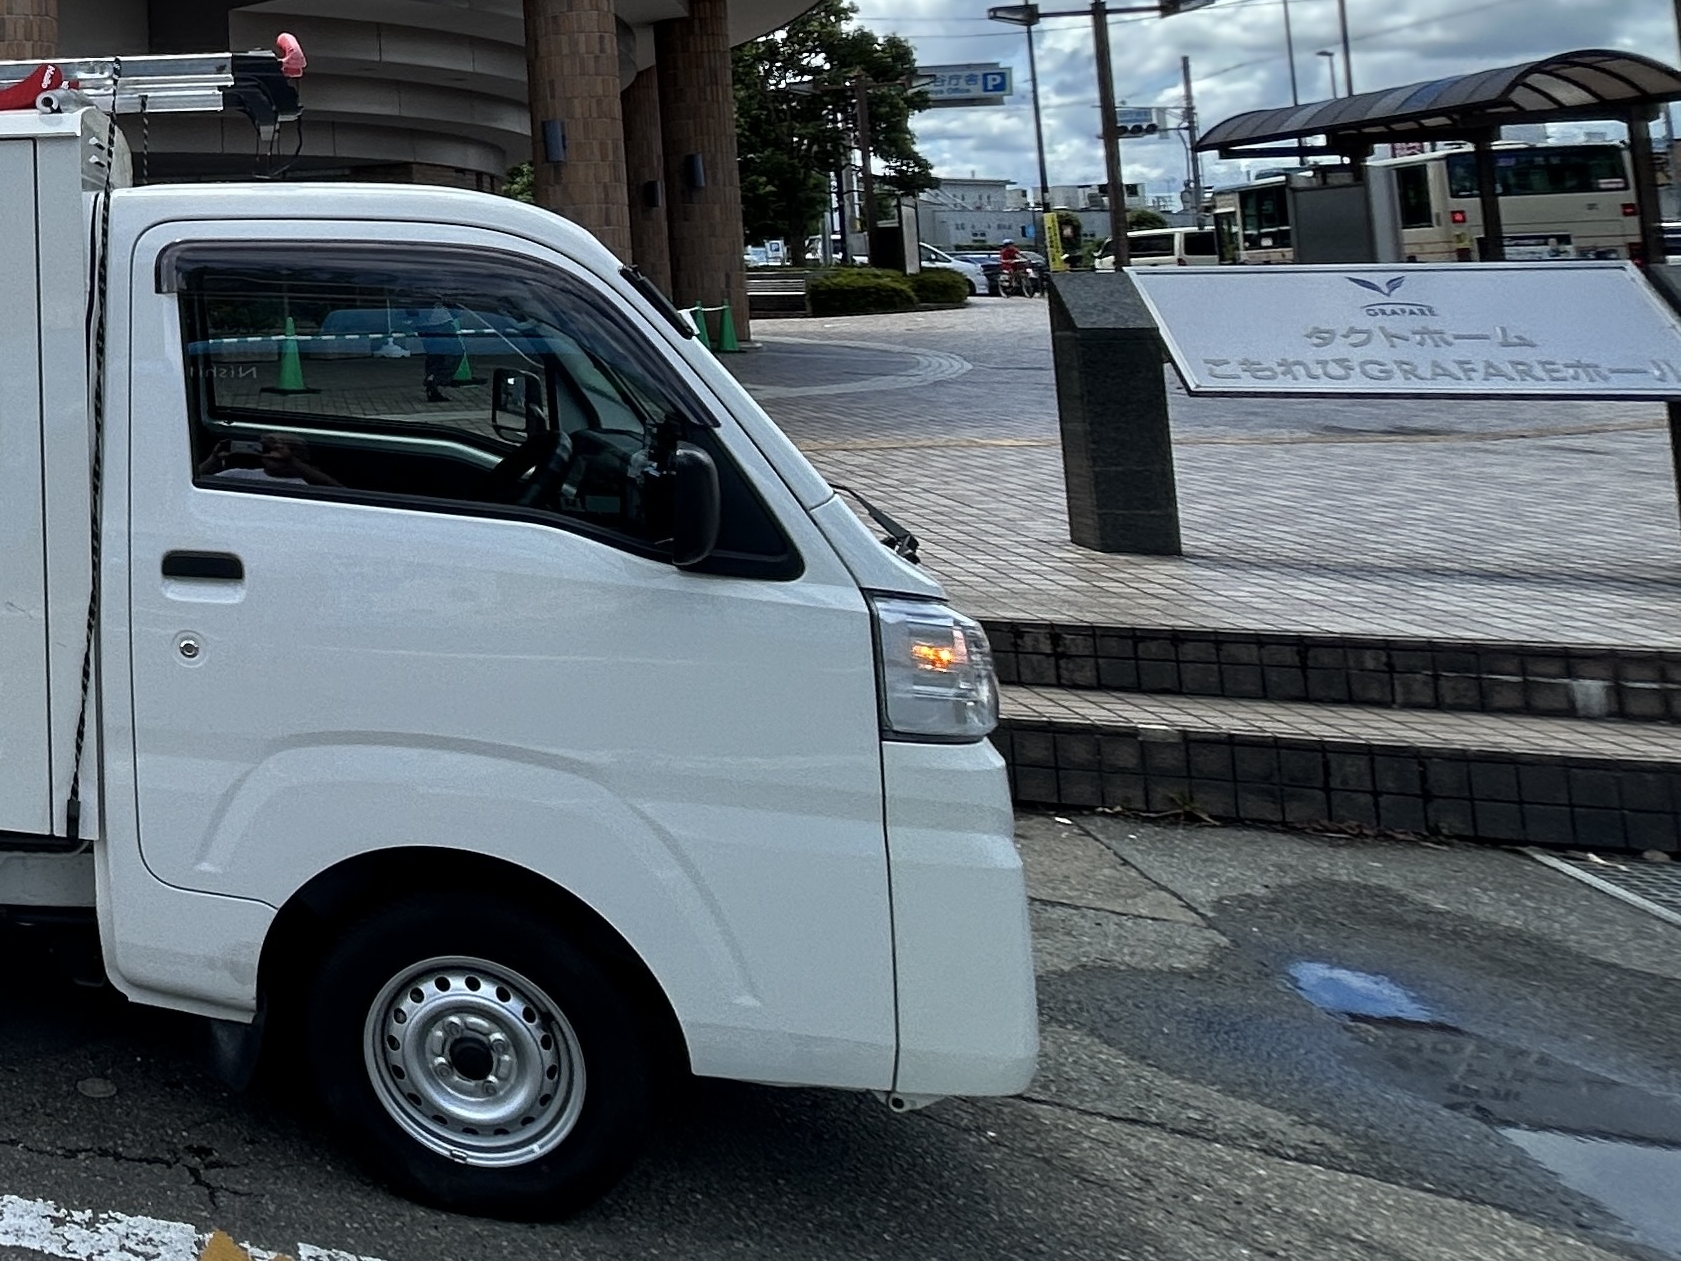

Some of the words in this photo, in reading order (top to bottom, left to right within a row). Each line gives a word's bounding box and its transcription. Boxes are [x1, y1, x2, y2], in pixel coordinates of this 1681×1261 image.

[1365, 307, 1439, 317] GRAFARE
[1303, 325, 1538, 348] タクトホーム
